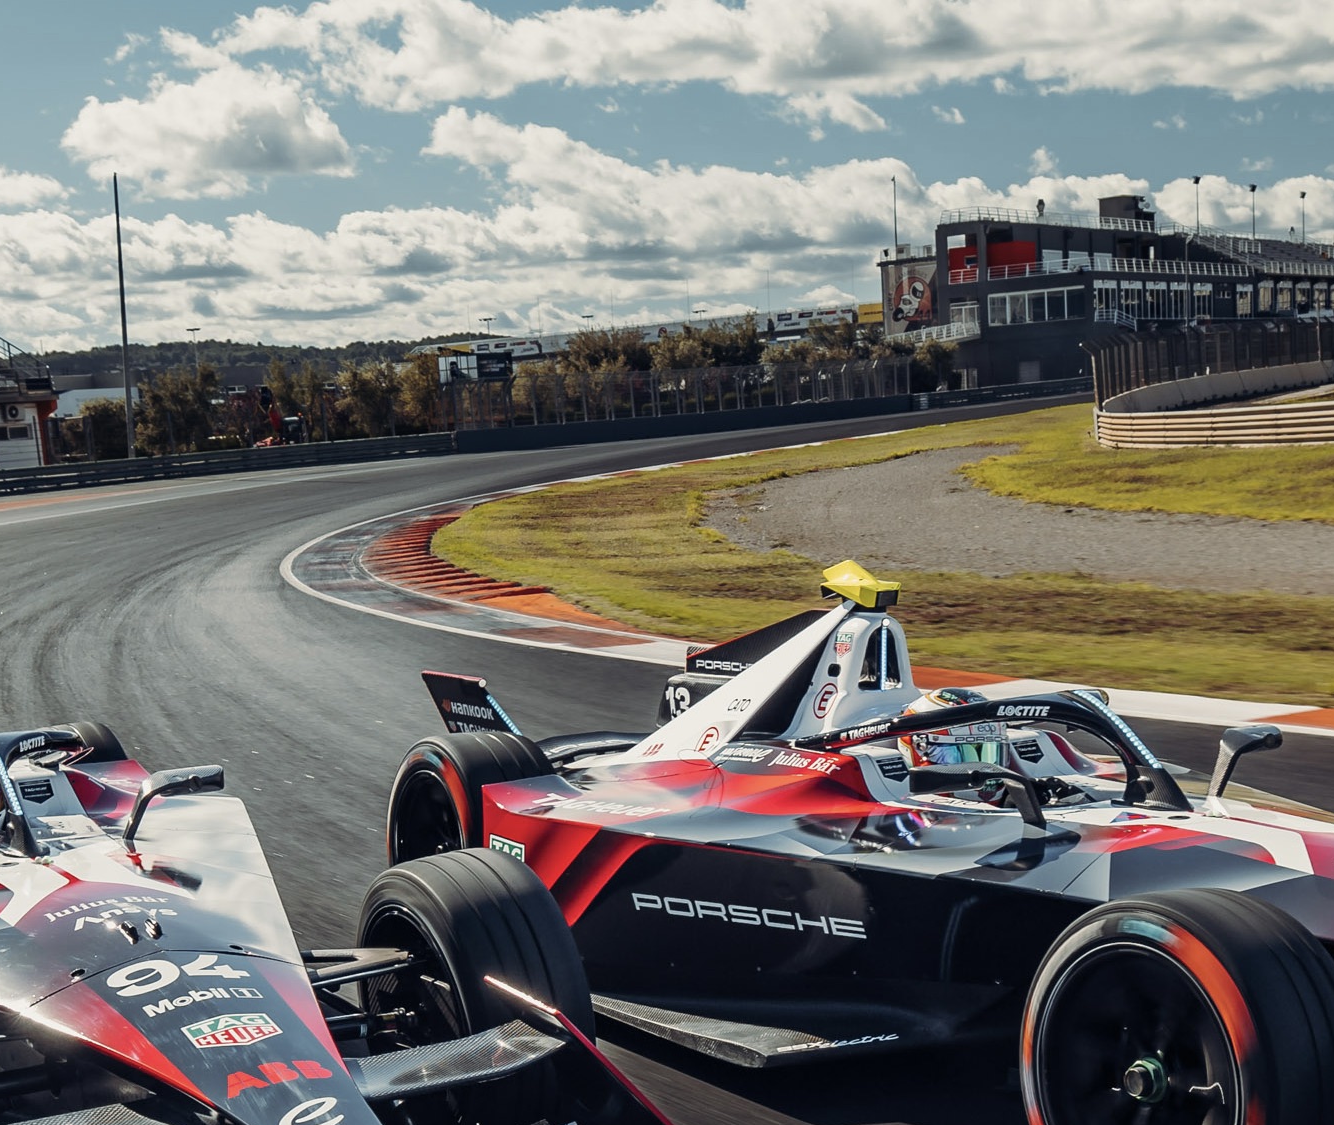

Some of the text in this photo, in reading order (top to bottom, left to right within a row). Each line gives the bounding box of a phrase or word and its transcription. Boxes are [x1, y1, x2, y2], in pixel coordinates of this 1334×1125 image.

[696, 660, 753, 671] PORSCH
[997, 706, 1050, 717] LOCTITE
[19, 736, 46, 752] LOCTITE
[44, 899, 119, 922] Julius
[631, 893, 867, 939] PORSCHE
[106, 955, 250, 997] 94
[142, 988, 231, 1018] Mobil
[190, 1015, 261, 1034] TAG
[197, 1025, 276, 1046] HEUER
[227, 1061, 332, 1098] ABB
